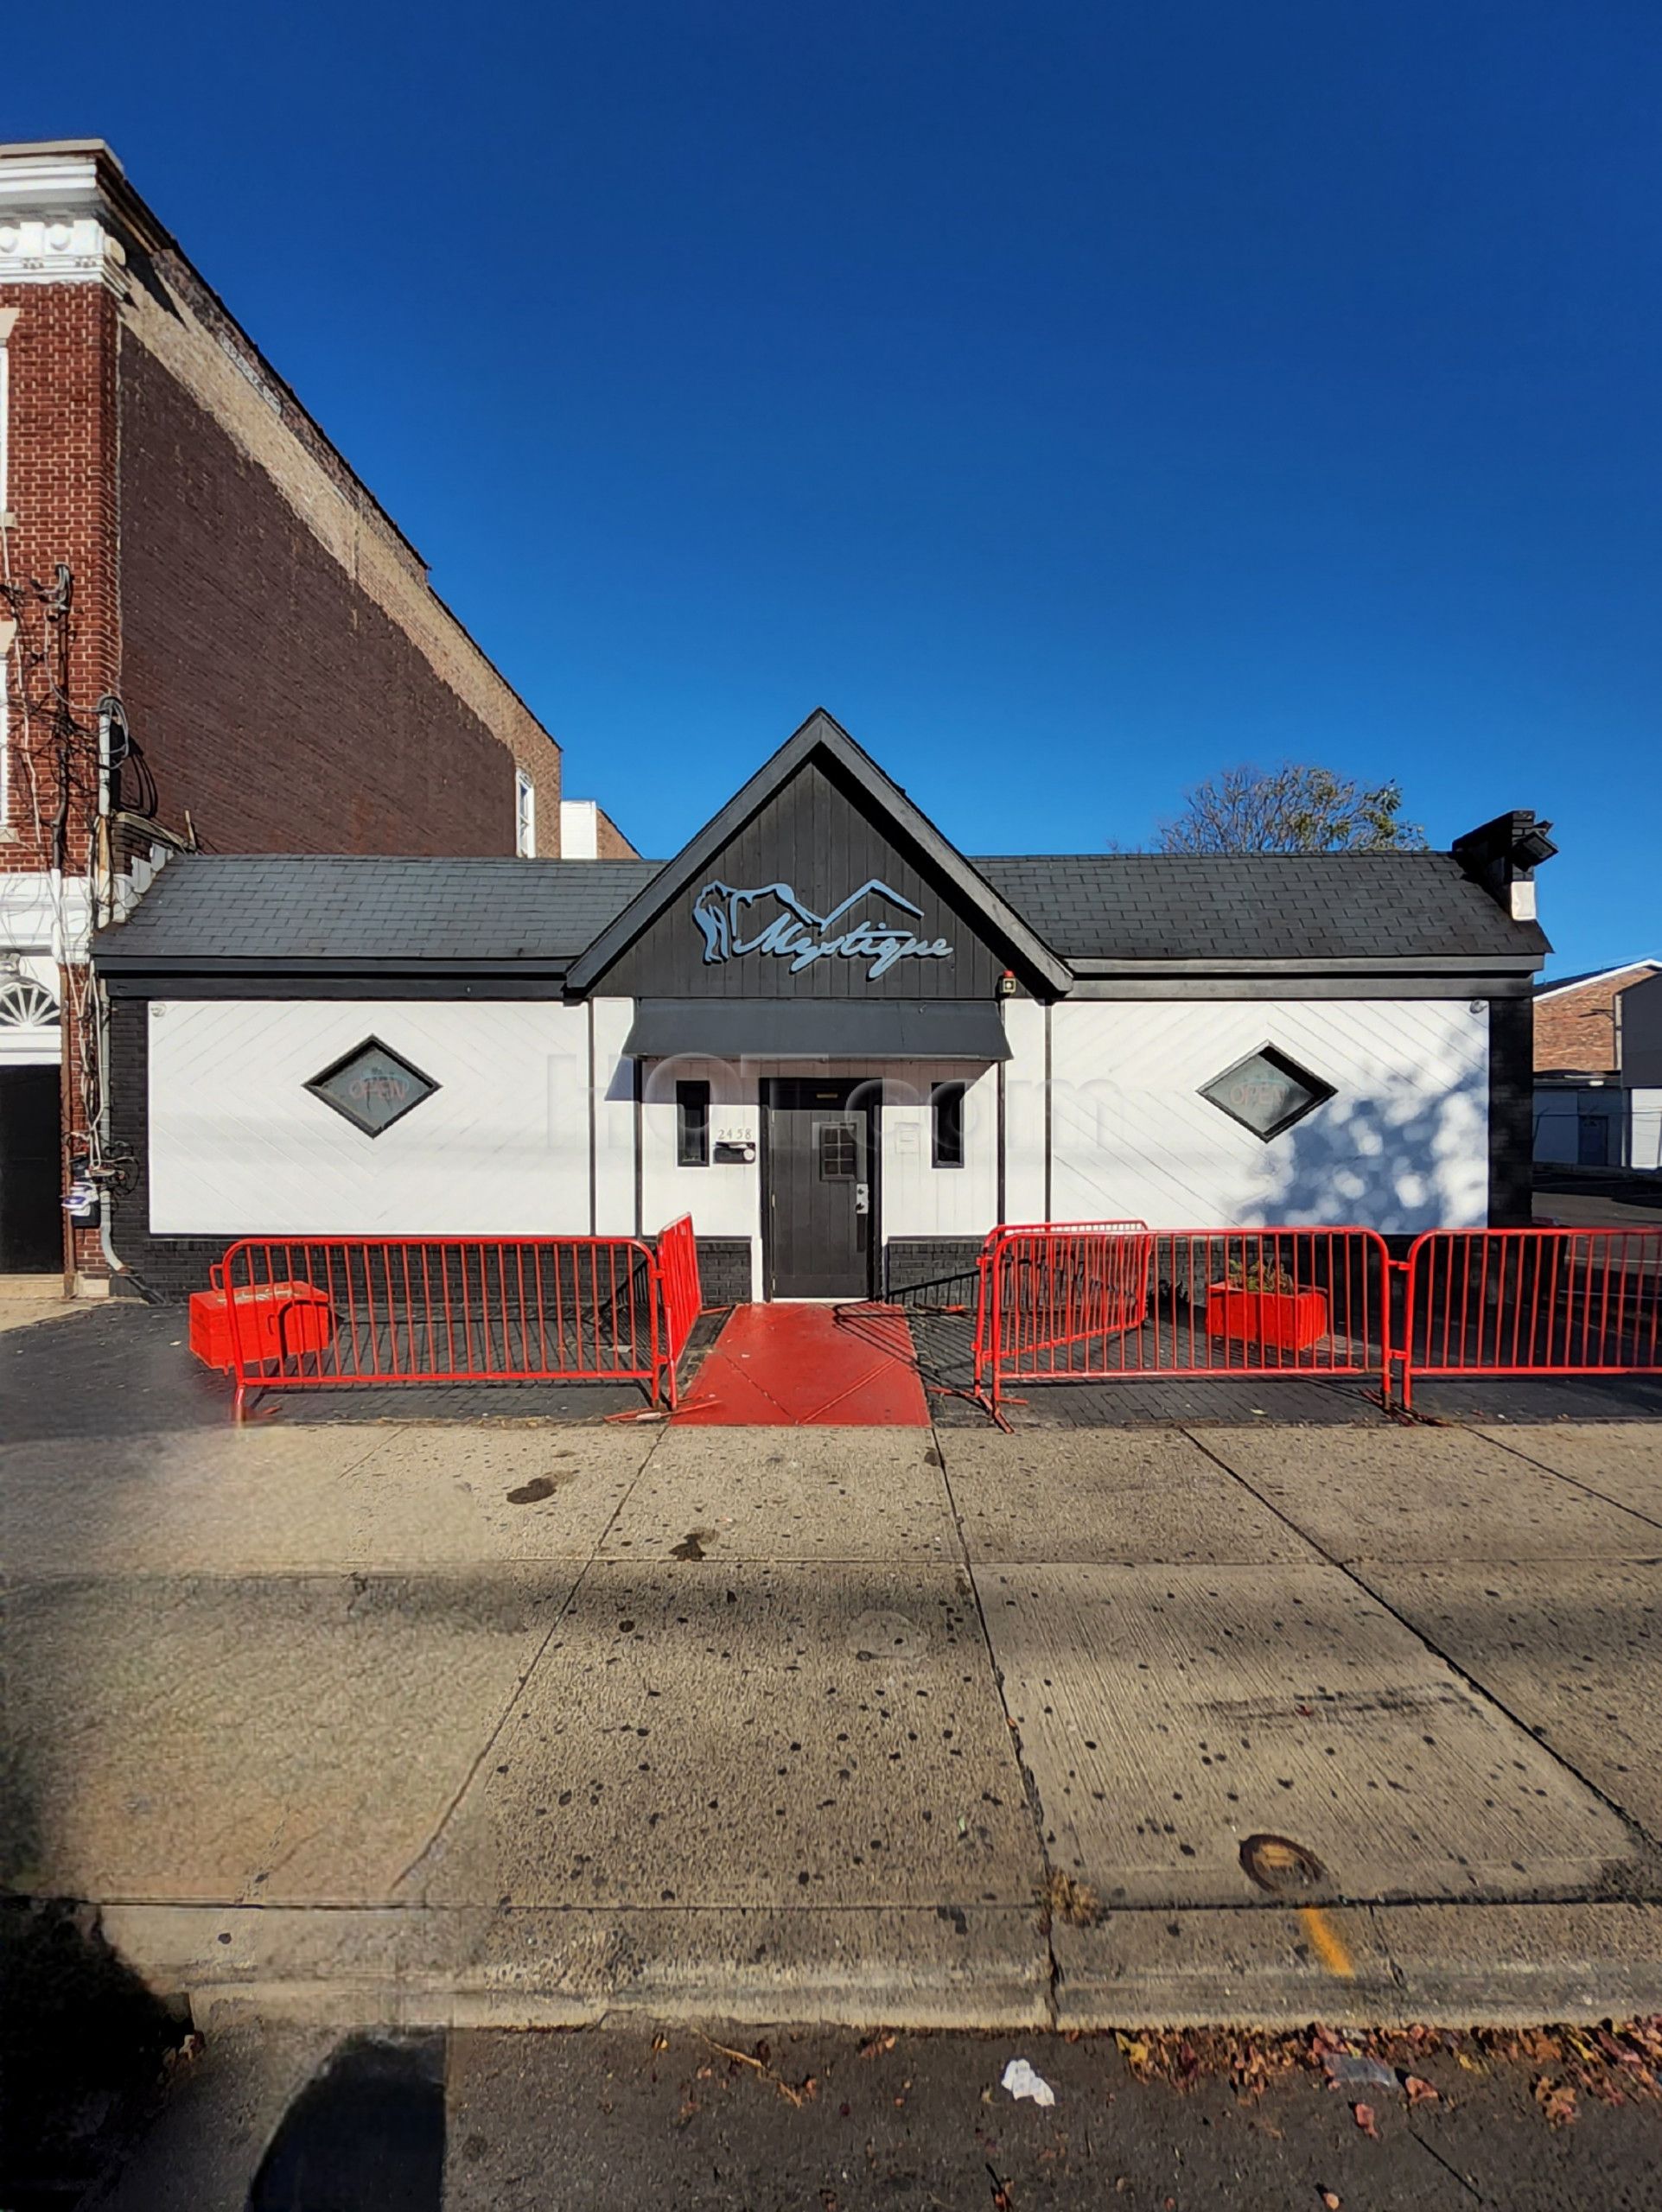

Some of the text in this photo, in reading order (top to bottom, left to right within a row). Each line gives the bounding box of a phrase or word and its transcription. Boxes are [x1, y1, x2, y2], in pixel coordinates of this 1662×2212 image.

[732, 912, 953, 979] Mystique
[349, 1078, 405, 1101] OPEN
[1230, 1083, 1286, 1106] OPEN
[718, 1128, 751, 1141] 2458
